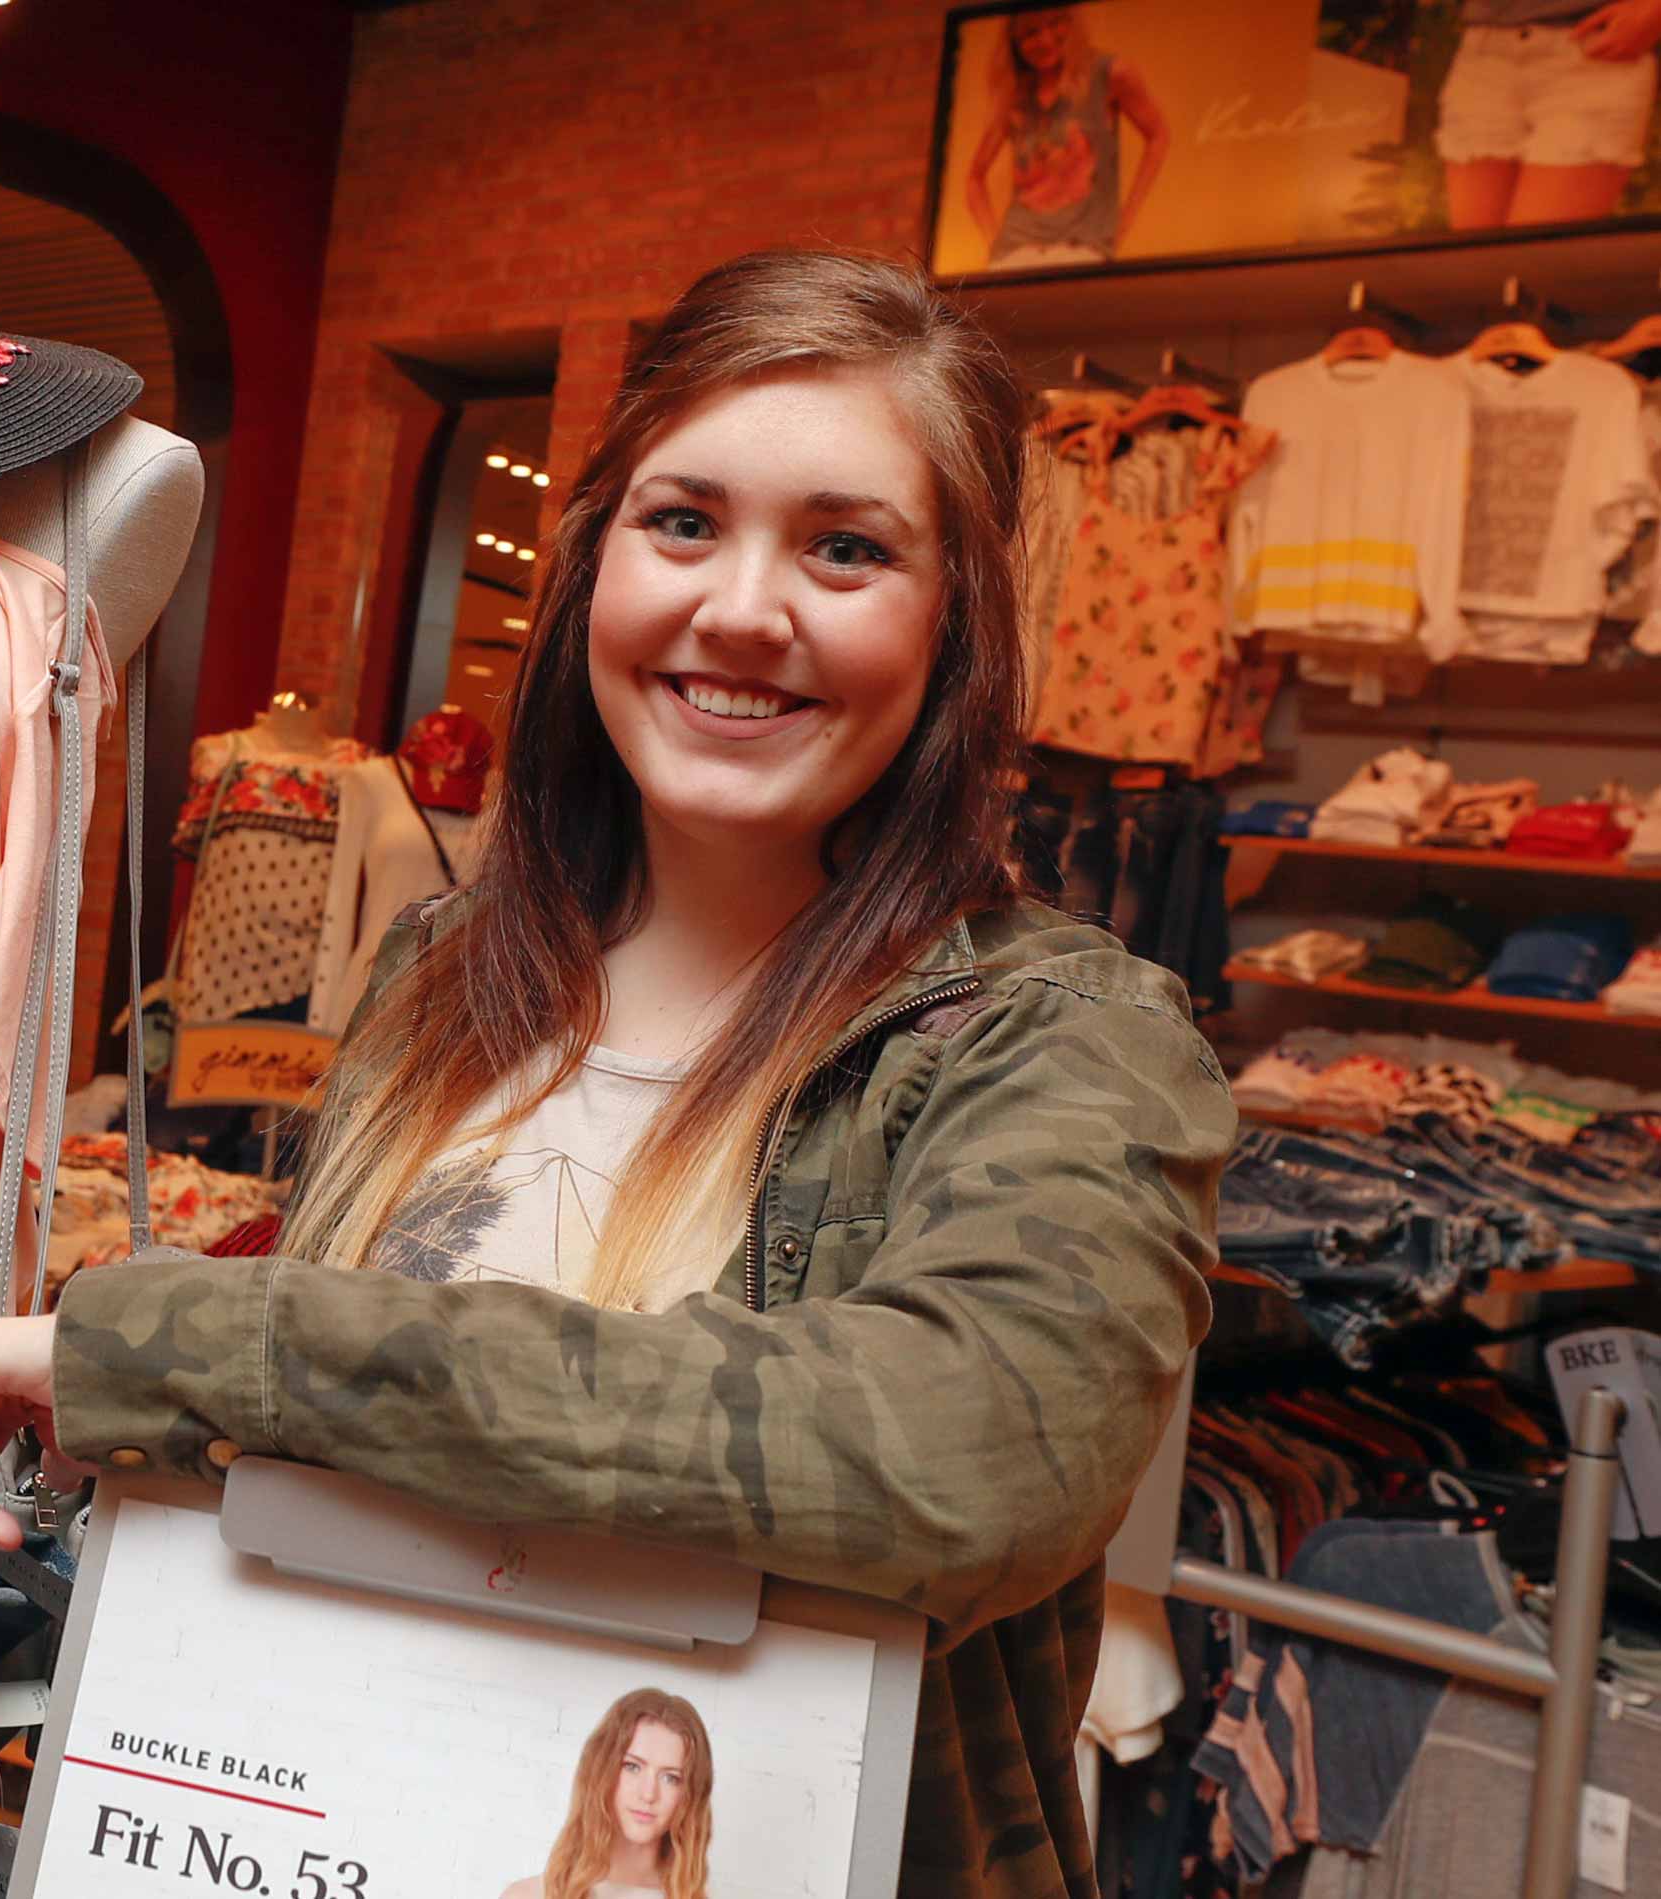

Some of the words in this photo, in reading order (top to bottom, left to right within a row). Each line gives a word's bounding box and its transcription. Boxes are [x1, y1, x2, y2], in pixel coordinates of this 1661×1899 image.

[1559, 1338, 1622, 1372] BKE
[110, 1731, 212, 1771] BUCKLE
[220, 1755, 309, 1792] BLACK
[88, 1803, 165, 1870] Fit
[178, 1824, 271, 1897] No.
[290, 1850, 369, 1899] 53
